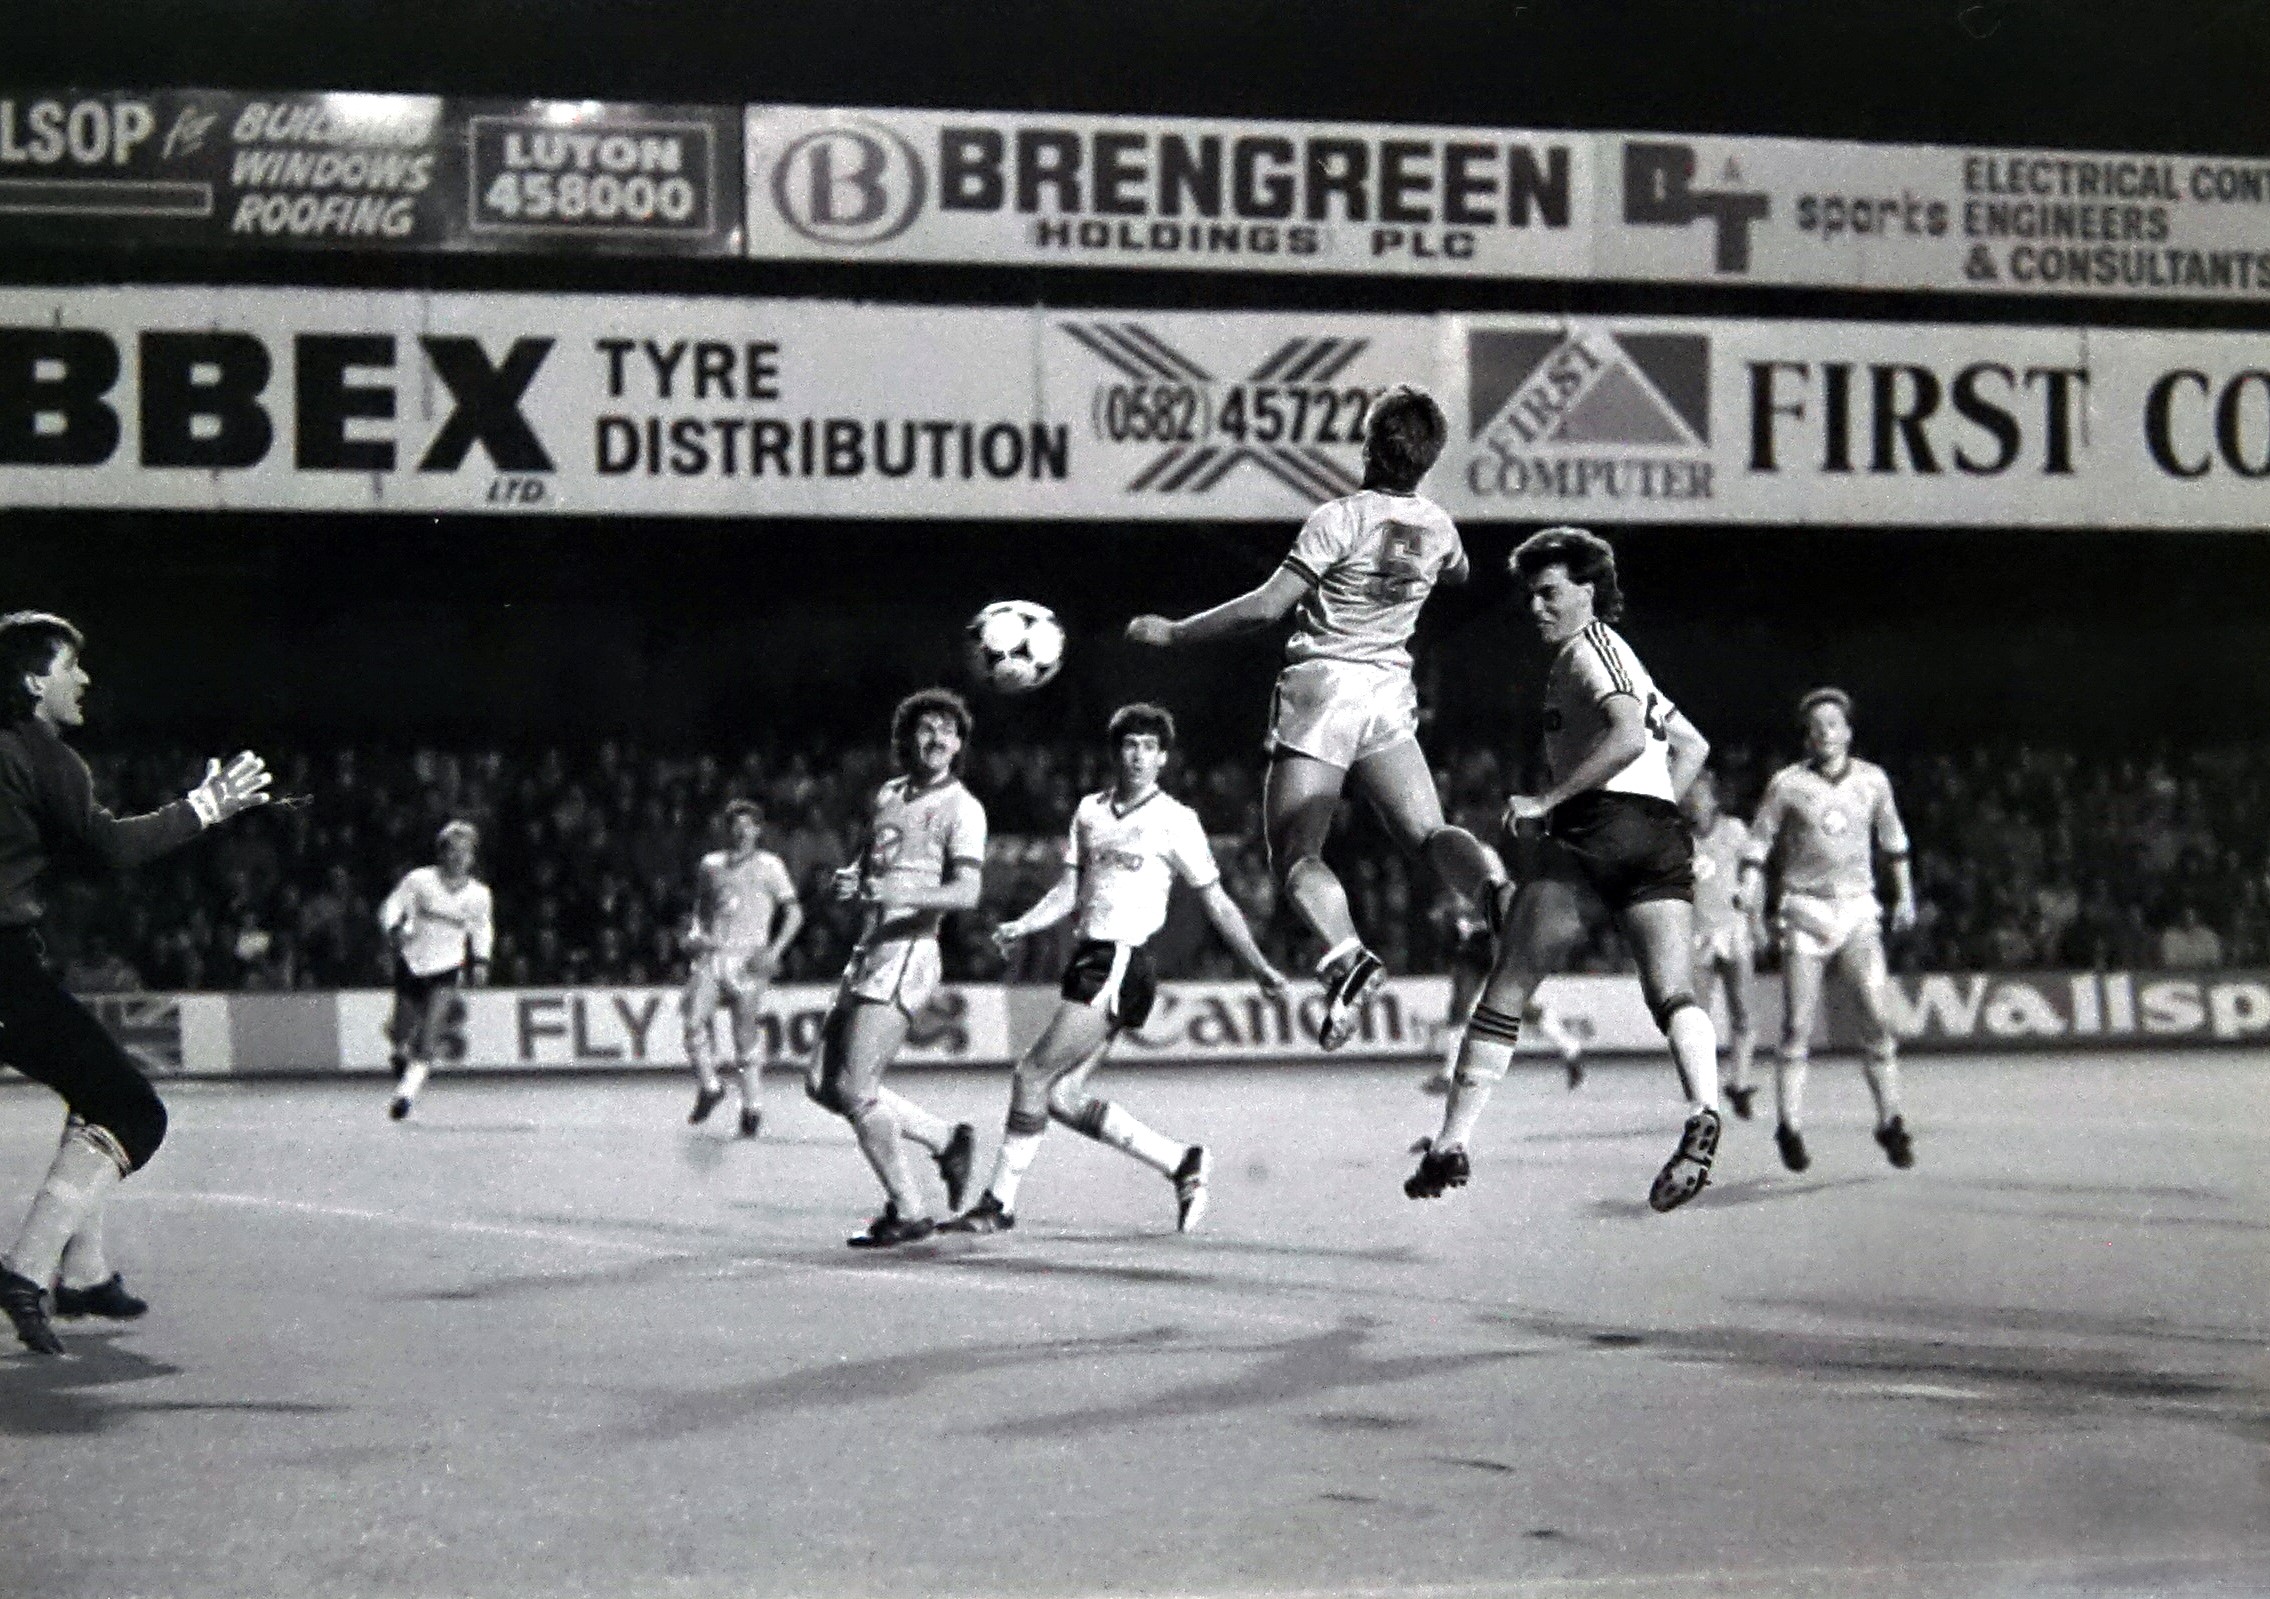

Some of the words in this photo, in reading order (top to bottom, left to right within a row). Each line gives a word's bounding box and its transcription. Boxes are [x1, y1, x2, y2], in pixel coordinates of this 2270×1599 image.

[0, 99, 154, 164] LSOP
[504, 132, 682, 172] LUTON
[231, 150, 434, 193] WINDOWS
[486, 170, 694, 222] 458000
[938, 126, 1571, 227] BRENGREEN
[1963, 156, 2179, 200] ELECTRICAL
[232, 193, 416, 237] ROOFING
[1034, 220, 1319, 257] HOLDINGS
[1371, 230, 1477, 260] PLC
[1963, 200, 2169, 241] ENGINEERS
[1963, 245, 1998, 281] &
[596, 340, 781, 401] TYRE
[0, 328, 557, 473] BBEX
[1217, 385, 1386, 443] 45722
[1746, 361, 2089, 475] FIRST
[2143, 367, 2270, 479] CO
[595, 418, 1069, 481] DISTRIBUTION
[485, 478, 546, 503] LTD
[1465, 455, 1715, 498] COMPUTER
[518, 997, 663, 1060] FLY
[1876, 972, 2270, 1040] Wallsp
